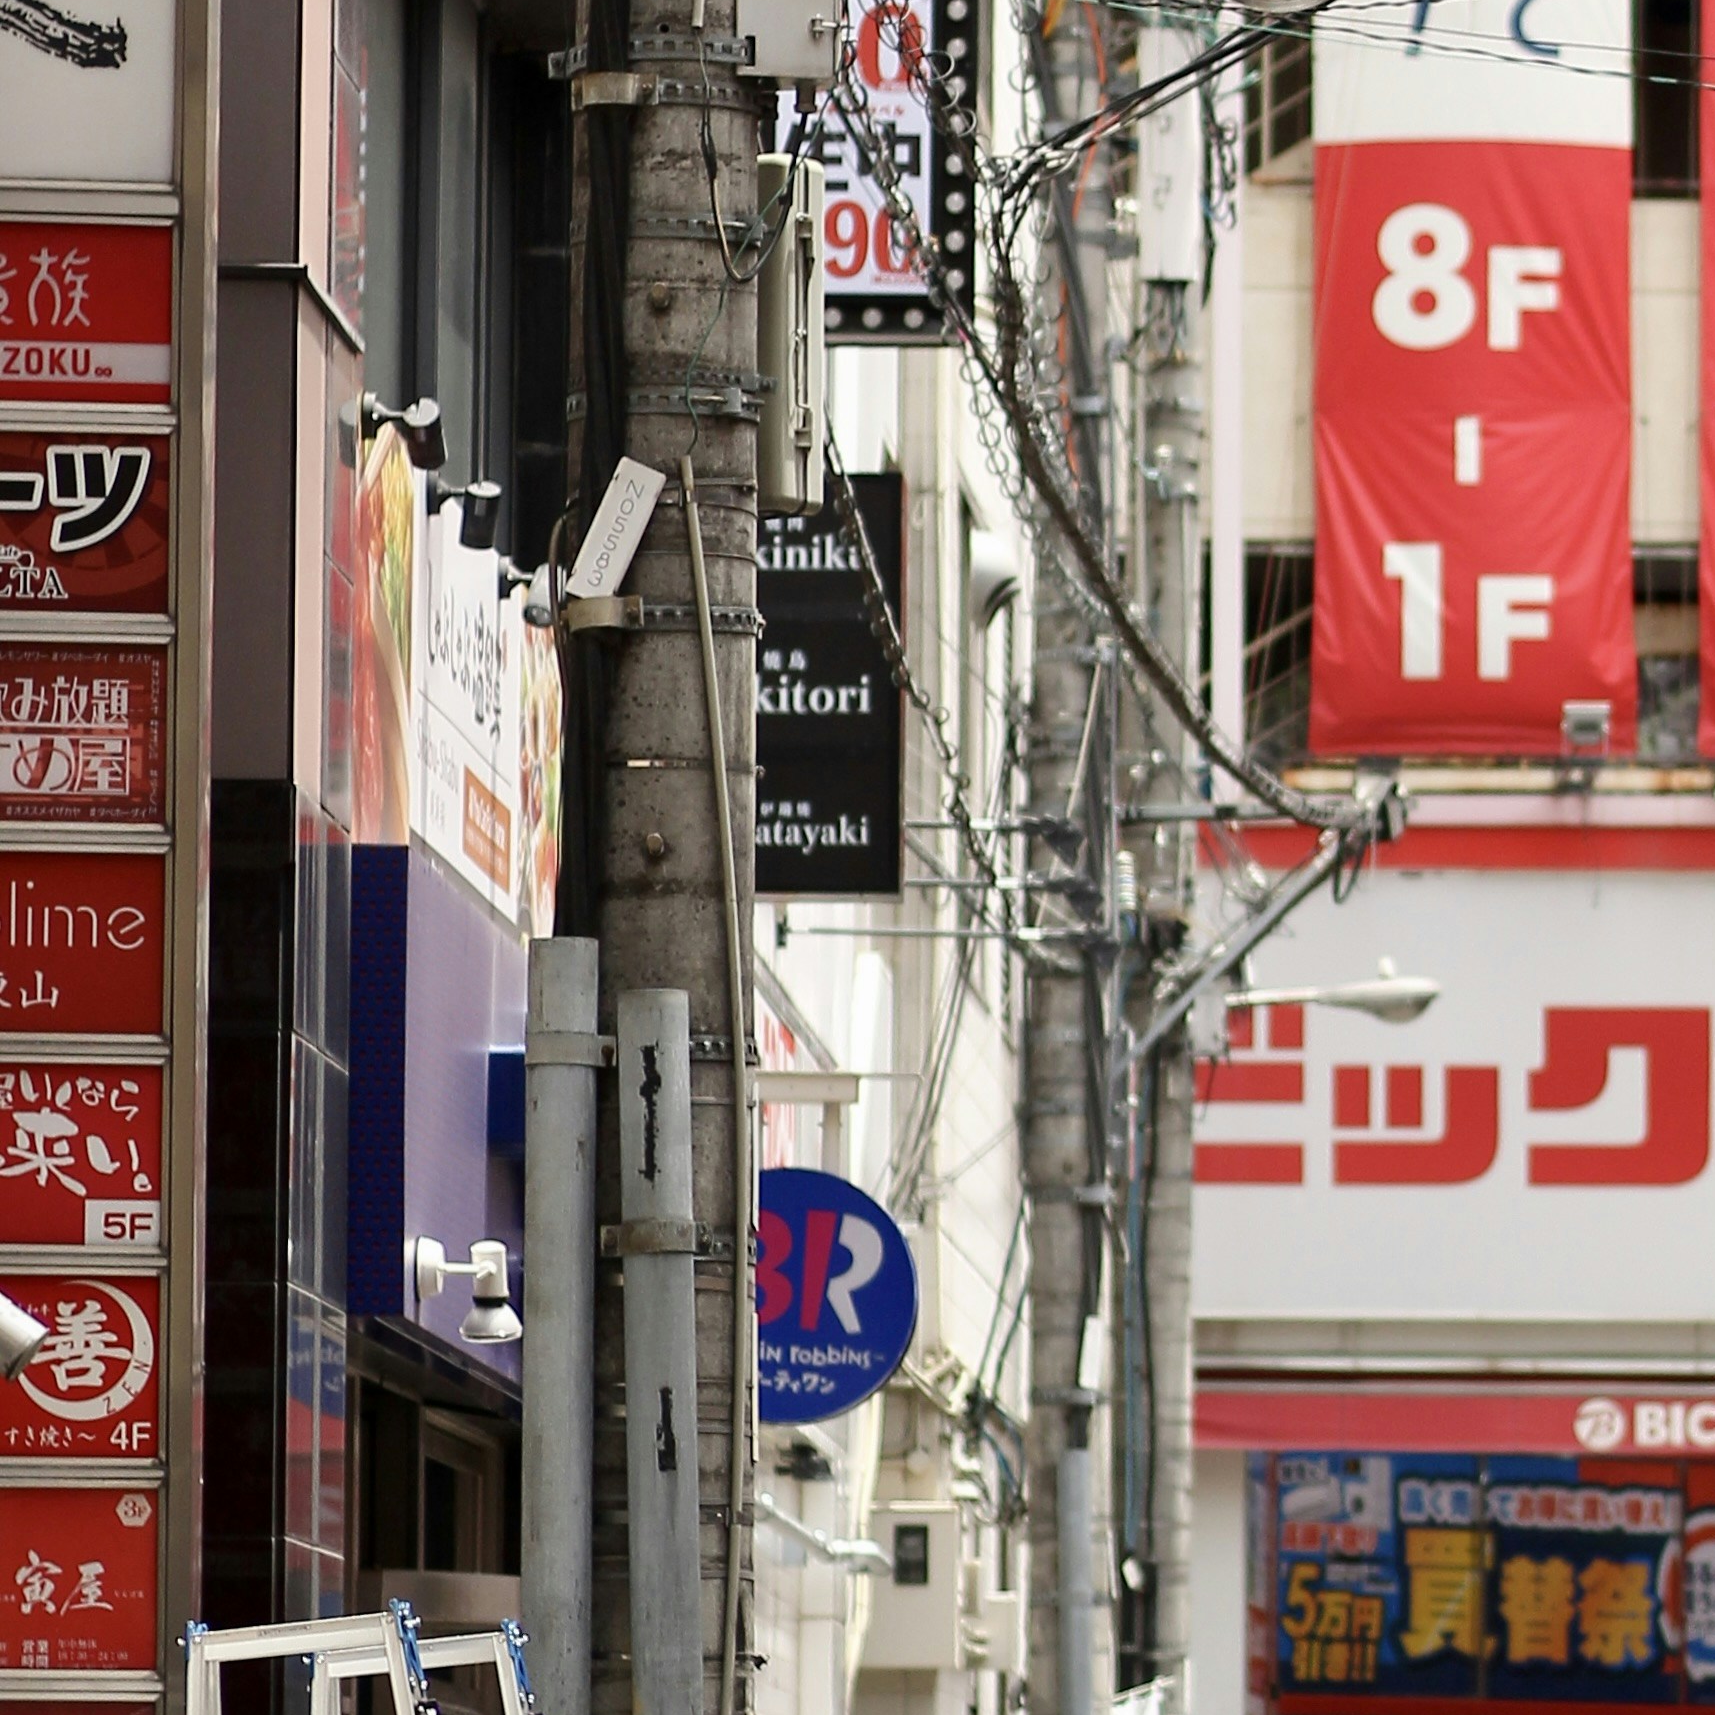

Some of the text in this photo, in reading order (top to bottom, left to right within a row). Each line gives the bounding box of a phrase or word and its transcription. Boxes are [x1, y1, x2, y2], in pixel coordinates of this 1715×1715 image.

[1371, 201, 1564, 353] 8F
[1382, 541, 1556, 681] 1F
[0, 675, 130, 727] み放題
[102, 1212, 154, 1241] 5F
[109, 1420, 152, 1452] 4F
[123, 1499, 148, 1519] 3F
